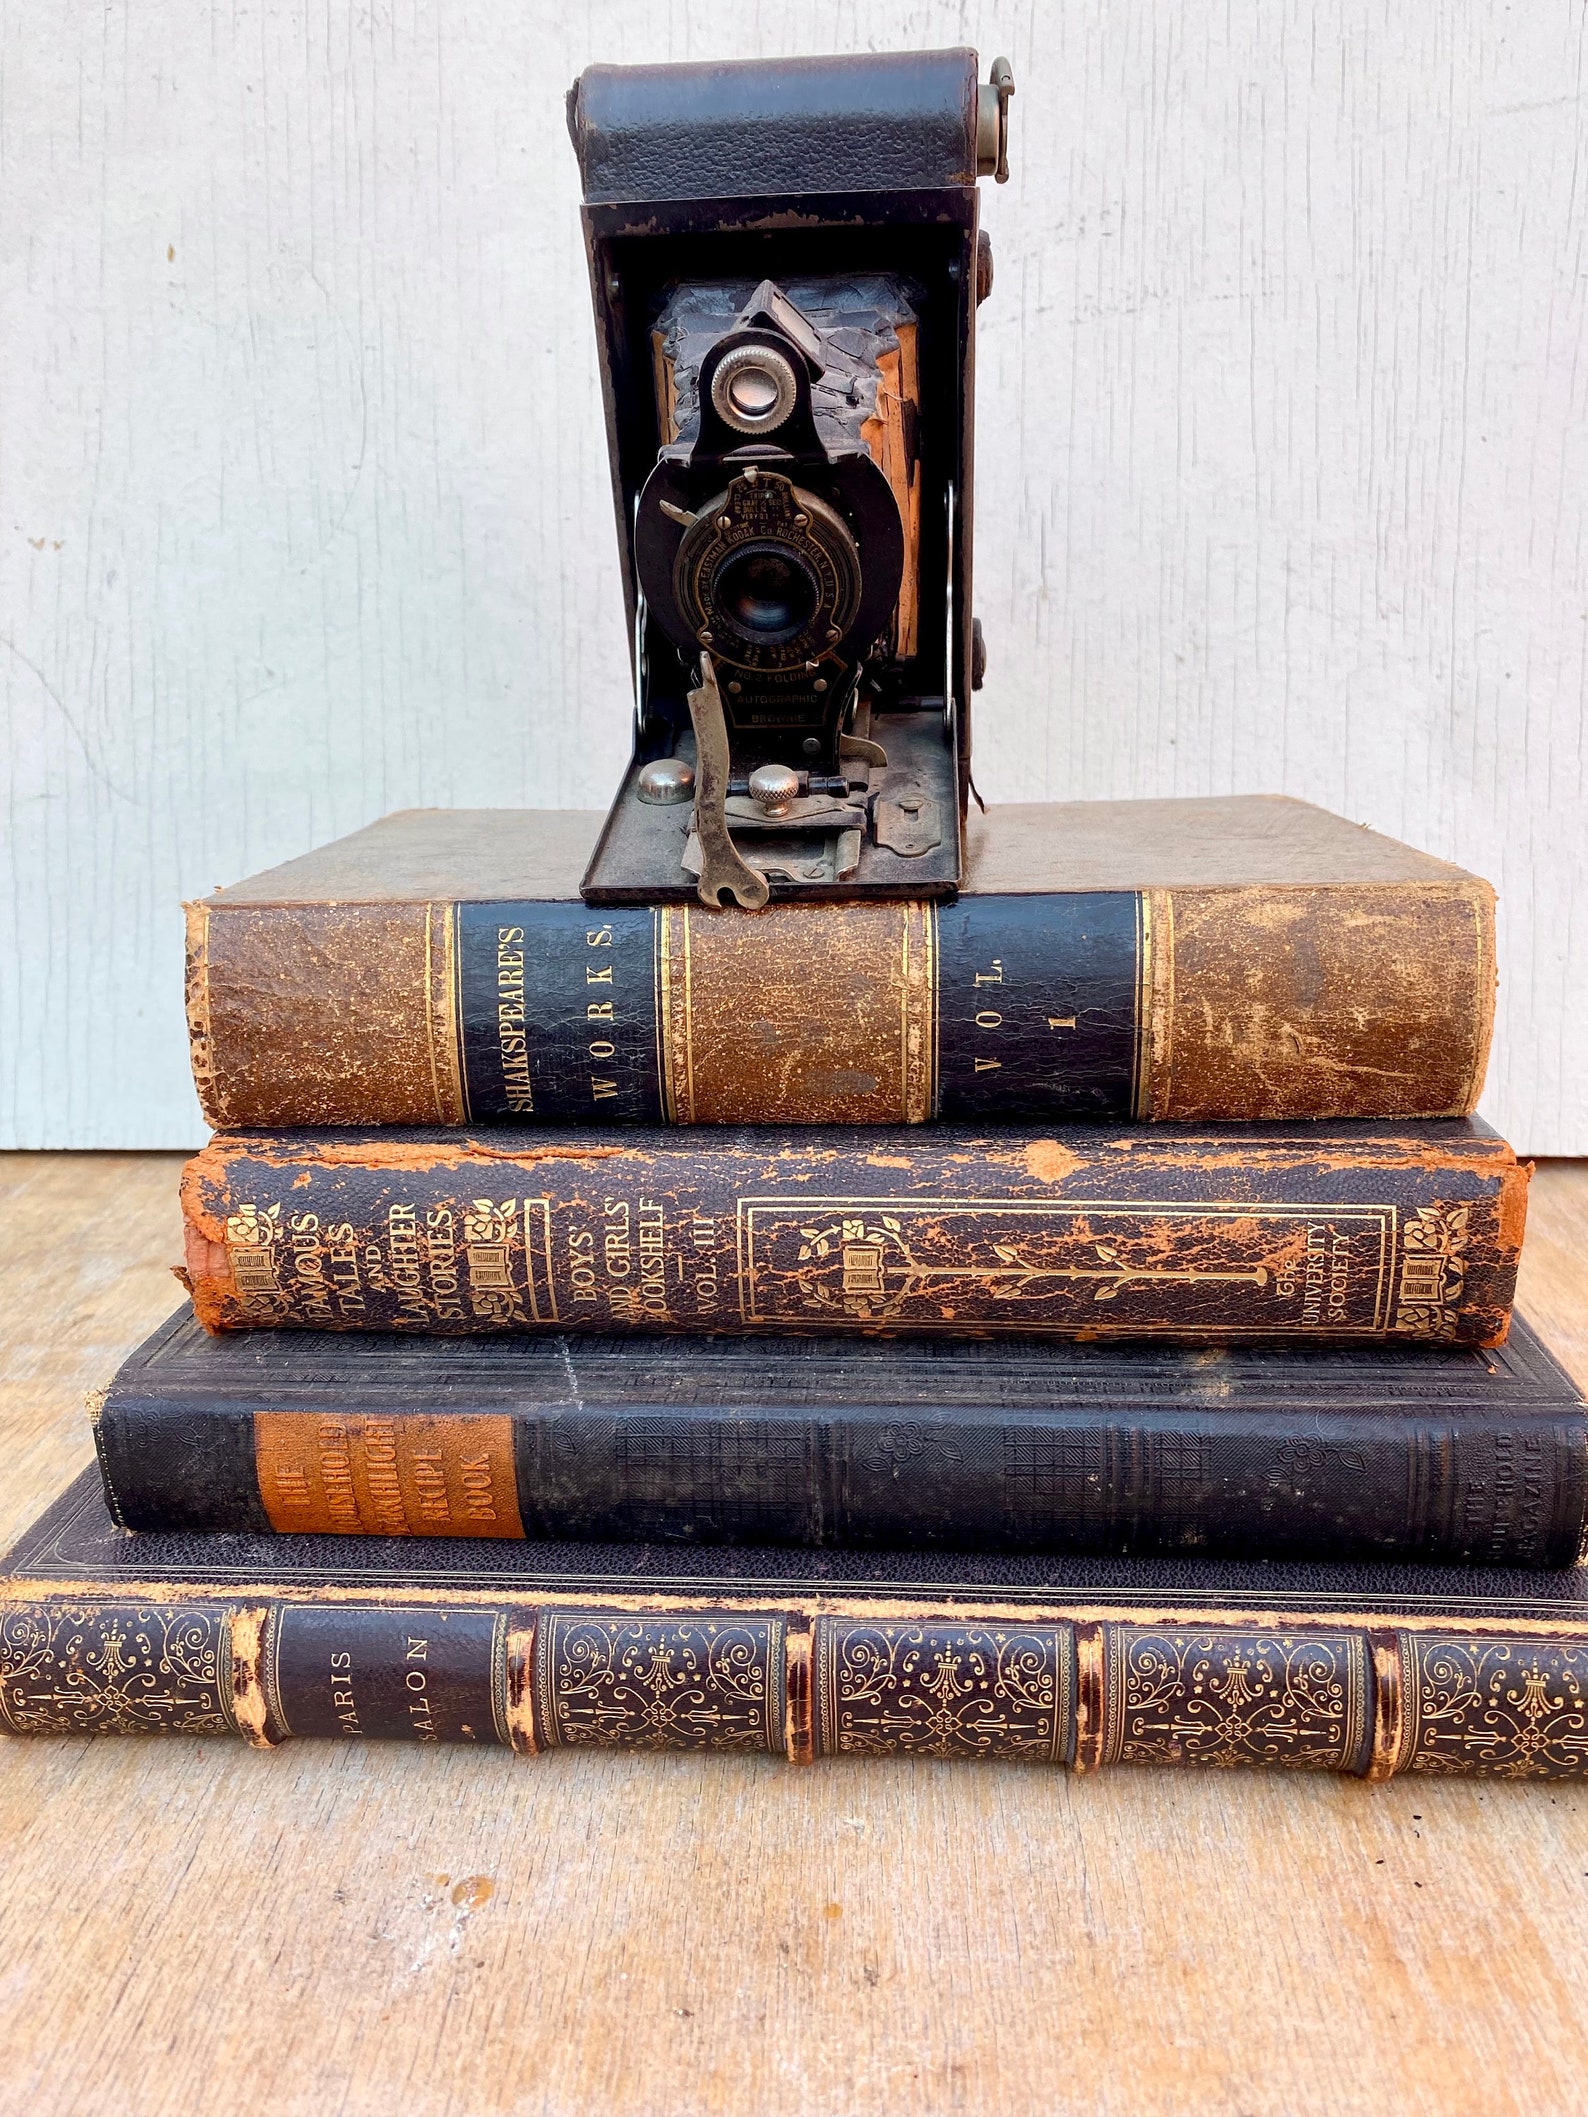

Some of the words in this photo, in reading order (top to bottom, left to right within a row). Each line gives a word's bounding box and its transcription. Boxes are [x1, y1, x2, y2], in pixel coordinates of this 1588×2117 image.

[700, 541, 727, 578] EASTMAN
[727, 525, 755, 544] KODAK
[737, 694, 818, 704] AUTOGRAPHIC
[767, 669, 817, 684] FOLDING
[751, 713, 807, 723] BROWNIE
[496, 926, 534, 1112] SHAKSPEARE'S
[974, 959, 1003, 1073] VOL.
[291, 1213, 334, 1319] FAMOUS
[327, 1222, 366, 1314] TALES
[365, 1244, 387, 1293] AND
[388, 1203, 431, 1324] LAUGHTER
[427, 1209, 467, 1320] STORIES
[568, 1225, 598, 1303] BOYS'
[604, 1196, 631, 1277] GIRLS'
[638, 1196, 670, 1323] BOOKSHELF
[692, 1217, 715, 1247] III
[606, 1286, 633, 1321] AND
[695, 1257, 718, 1312] VOL.
[1275, 1259, 1297, 1296] The
[1301, 1220, 1326, 1325] UNIVERSITY
[1327, 1231, 1350, 1321] SOCIETY
[274, 1465, 312, 1507] THE
[413, 1449, 452, 1521] RECIPE
[459, 1453, 498, 1520] BOOK
[330, 1651, 364, 1735] PARIS
[405, 1636, 438, 1741] SALON
